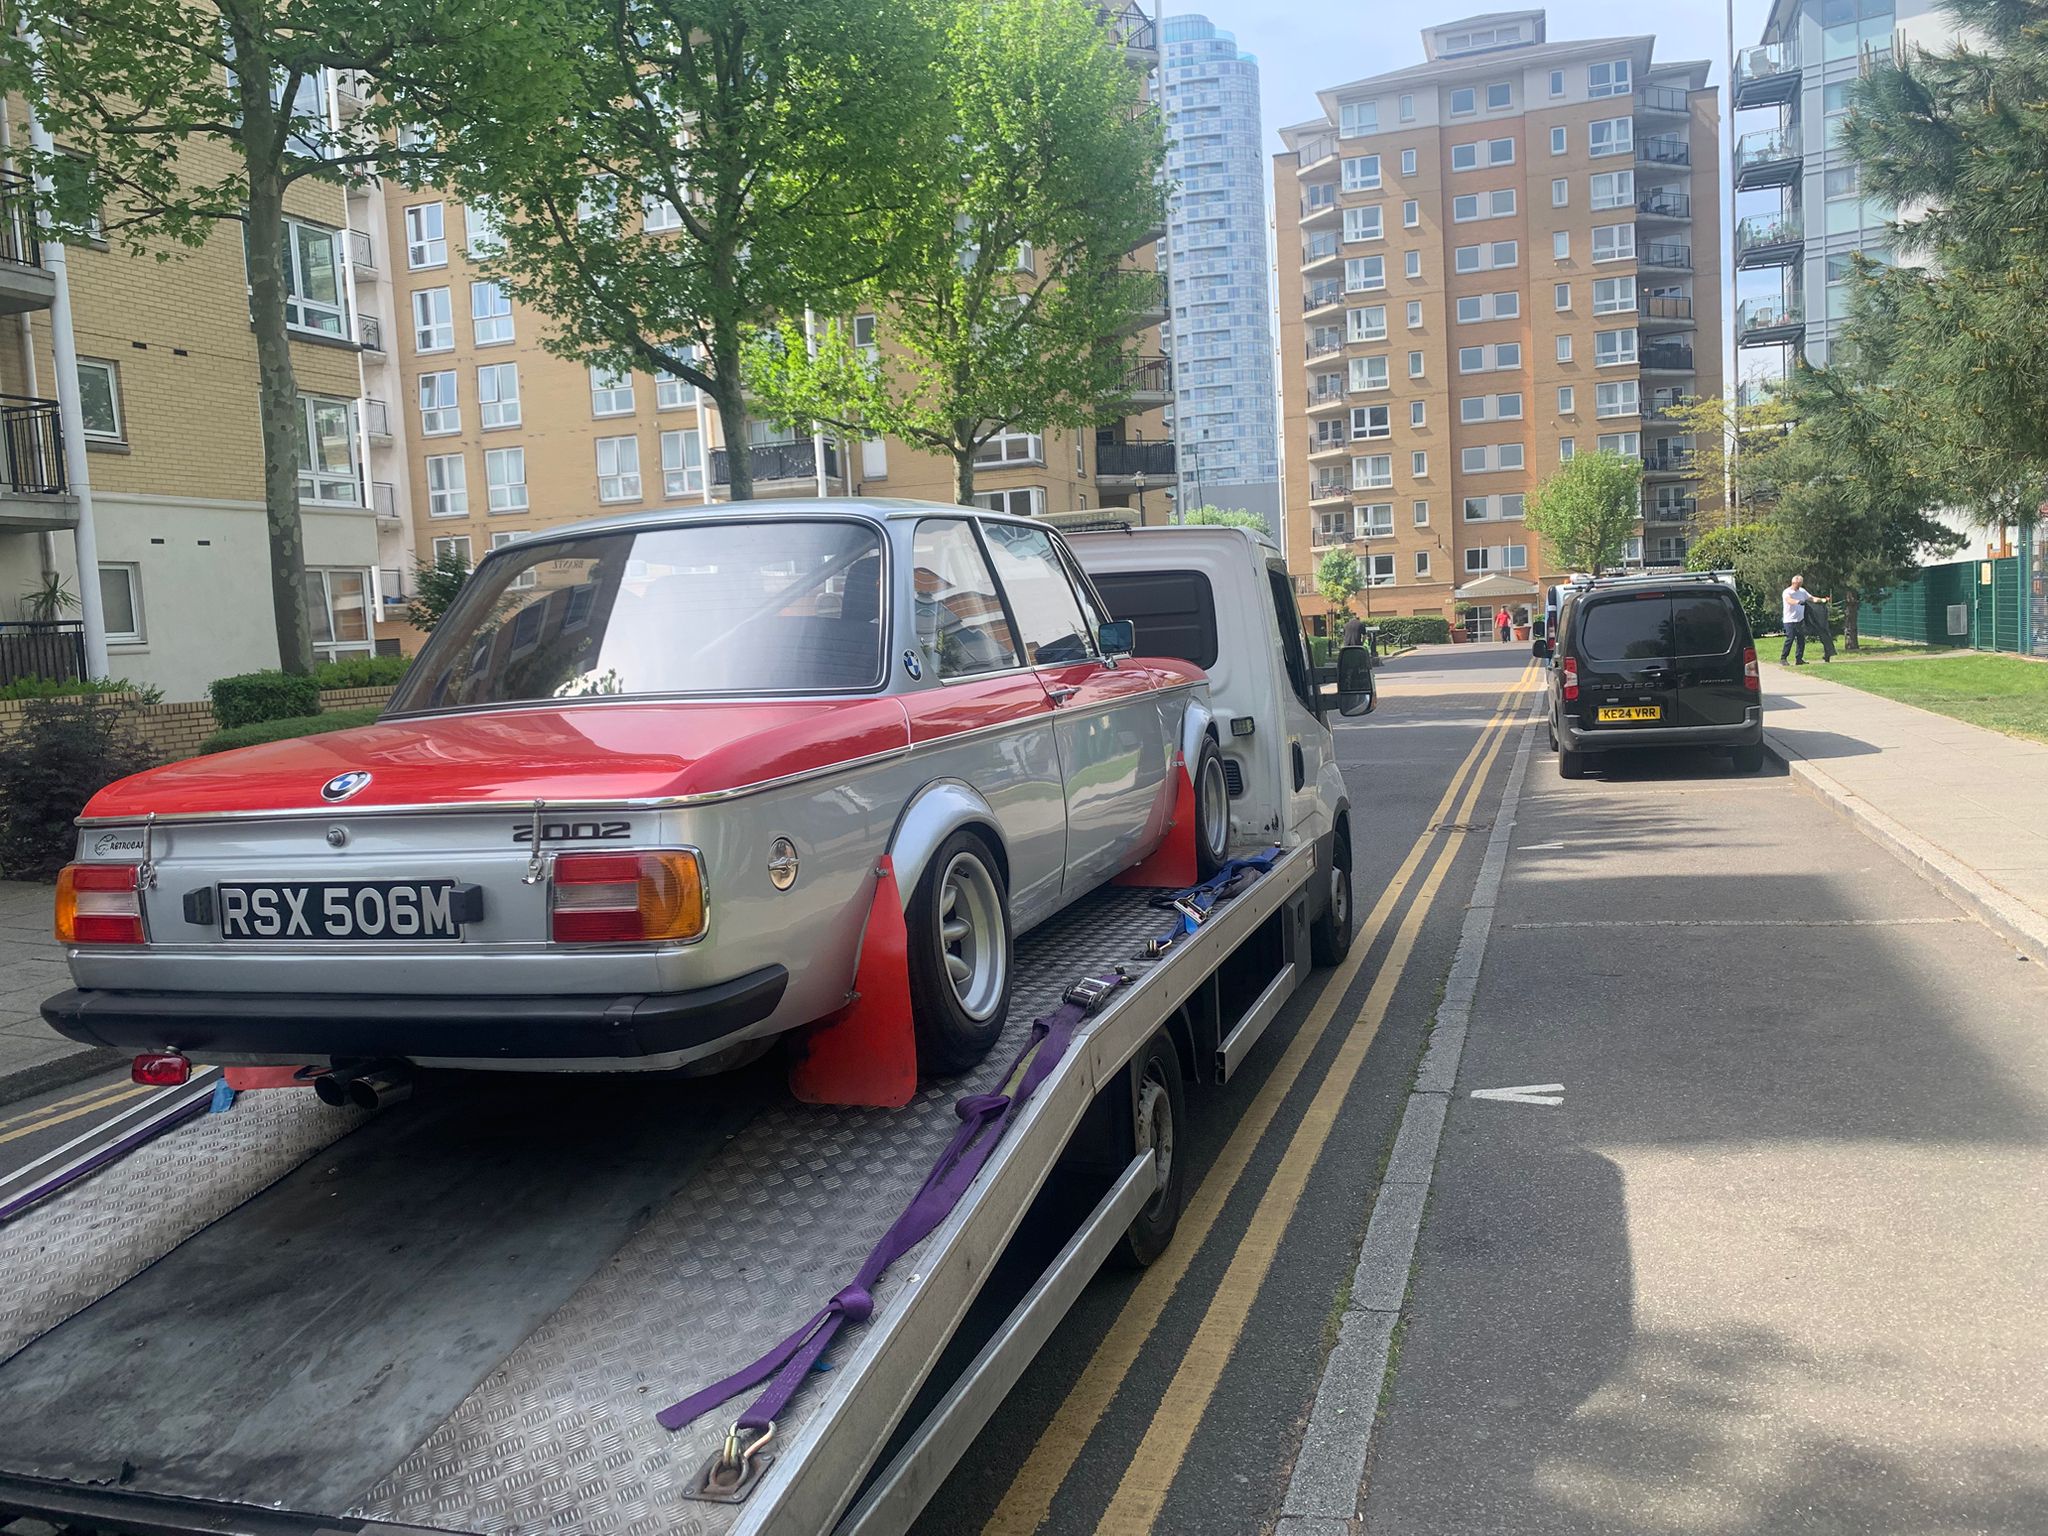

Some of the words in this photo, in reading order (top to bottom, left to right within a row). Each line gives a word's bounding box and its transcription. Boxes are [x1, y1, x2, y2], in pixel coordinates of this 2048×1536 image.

[1591, 682, 1665, 690] PEUGEOT
[1604, 709, 1632, 719] KE24
[1635, 708, 1656, 718] VRR
[513, 821, 631, 842] 2002
[221, 888, 312, 936] RSX
[323, 886, 456, 936] 506M
